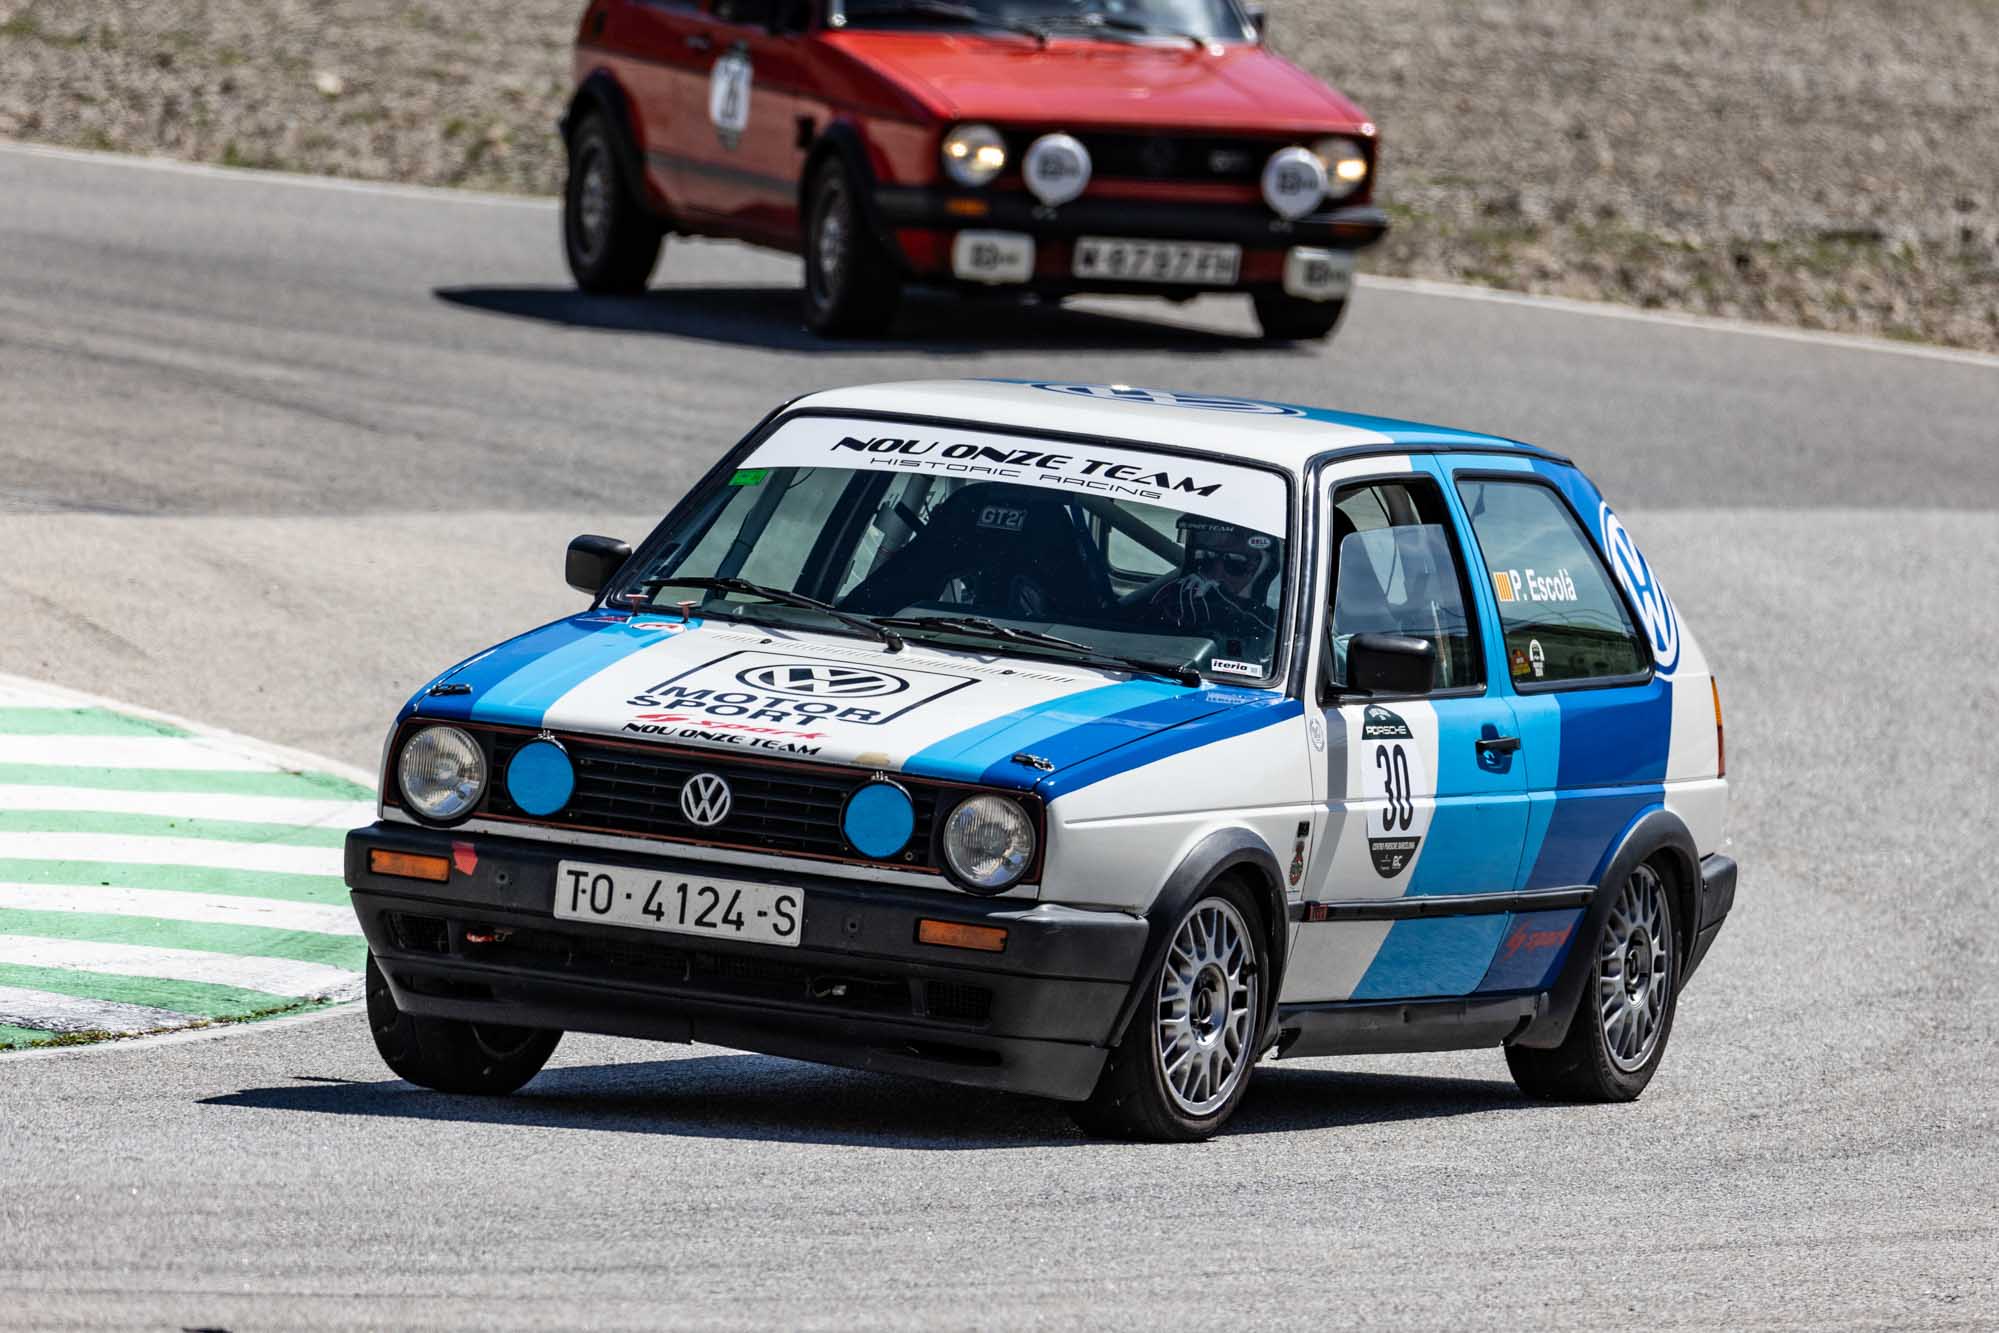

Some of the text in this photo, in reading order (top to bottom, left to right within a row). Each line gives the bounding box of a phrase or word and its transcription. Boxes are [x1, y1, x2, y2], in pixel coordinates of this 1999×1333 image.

[830, 436, 1224, 498] NOU ONZE TEAM
[870, 456, 1163, 500] HISTORIC RACING
[1508, 567, 1578, 601] P. Escolà
[626, 694, 830, 726] SPORT
[658, 686, 881, 722] MOTOR
[621, 722, 823, 756] NOU ONZE TEAM
[1365, 725, 1407, 736] PORSCHE
[1376, 744, 1414, 832] 30
